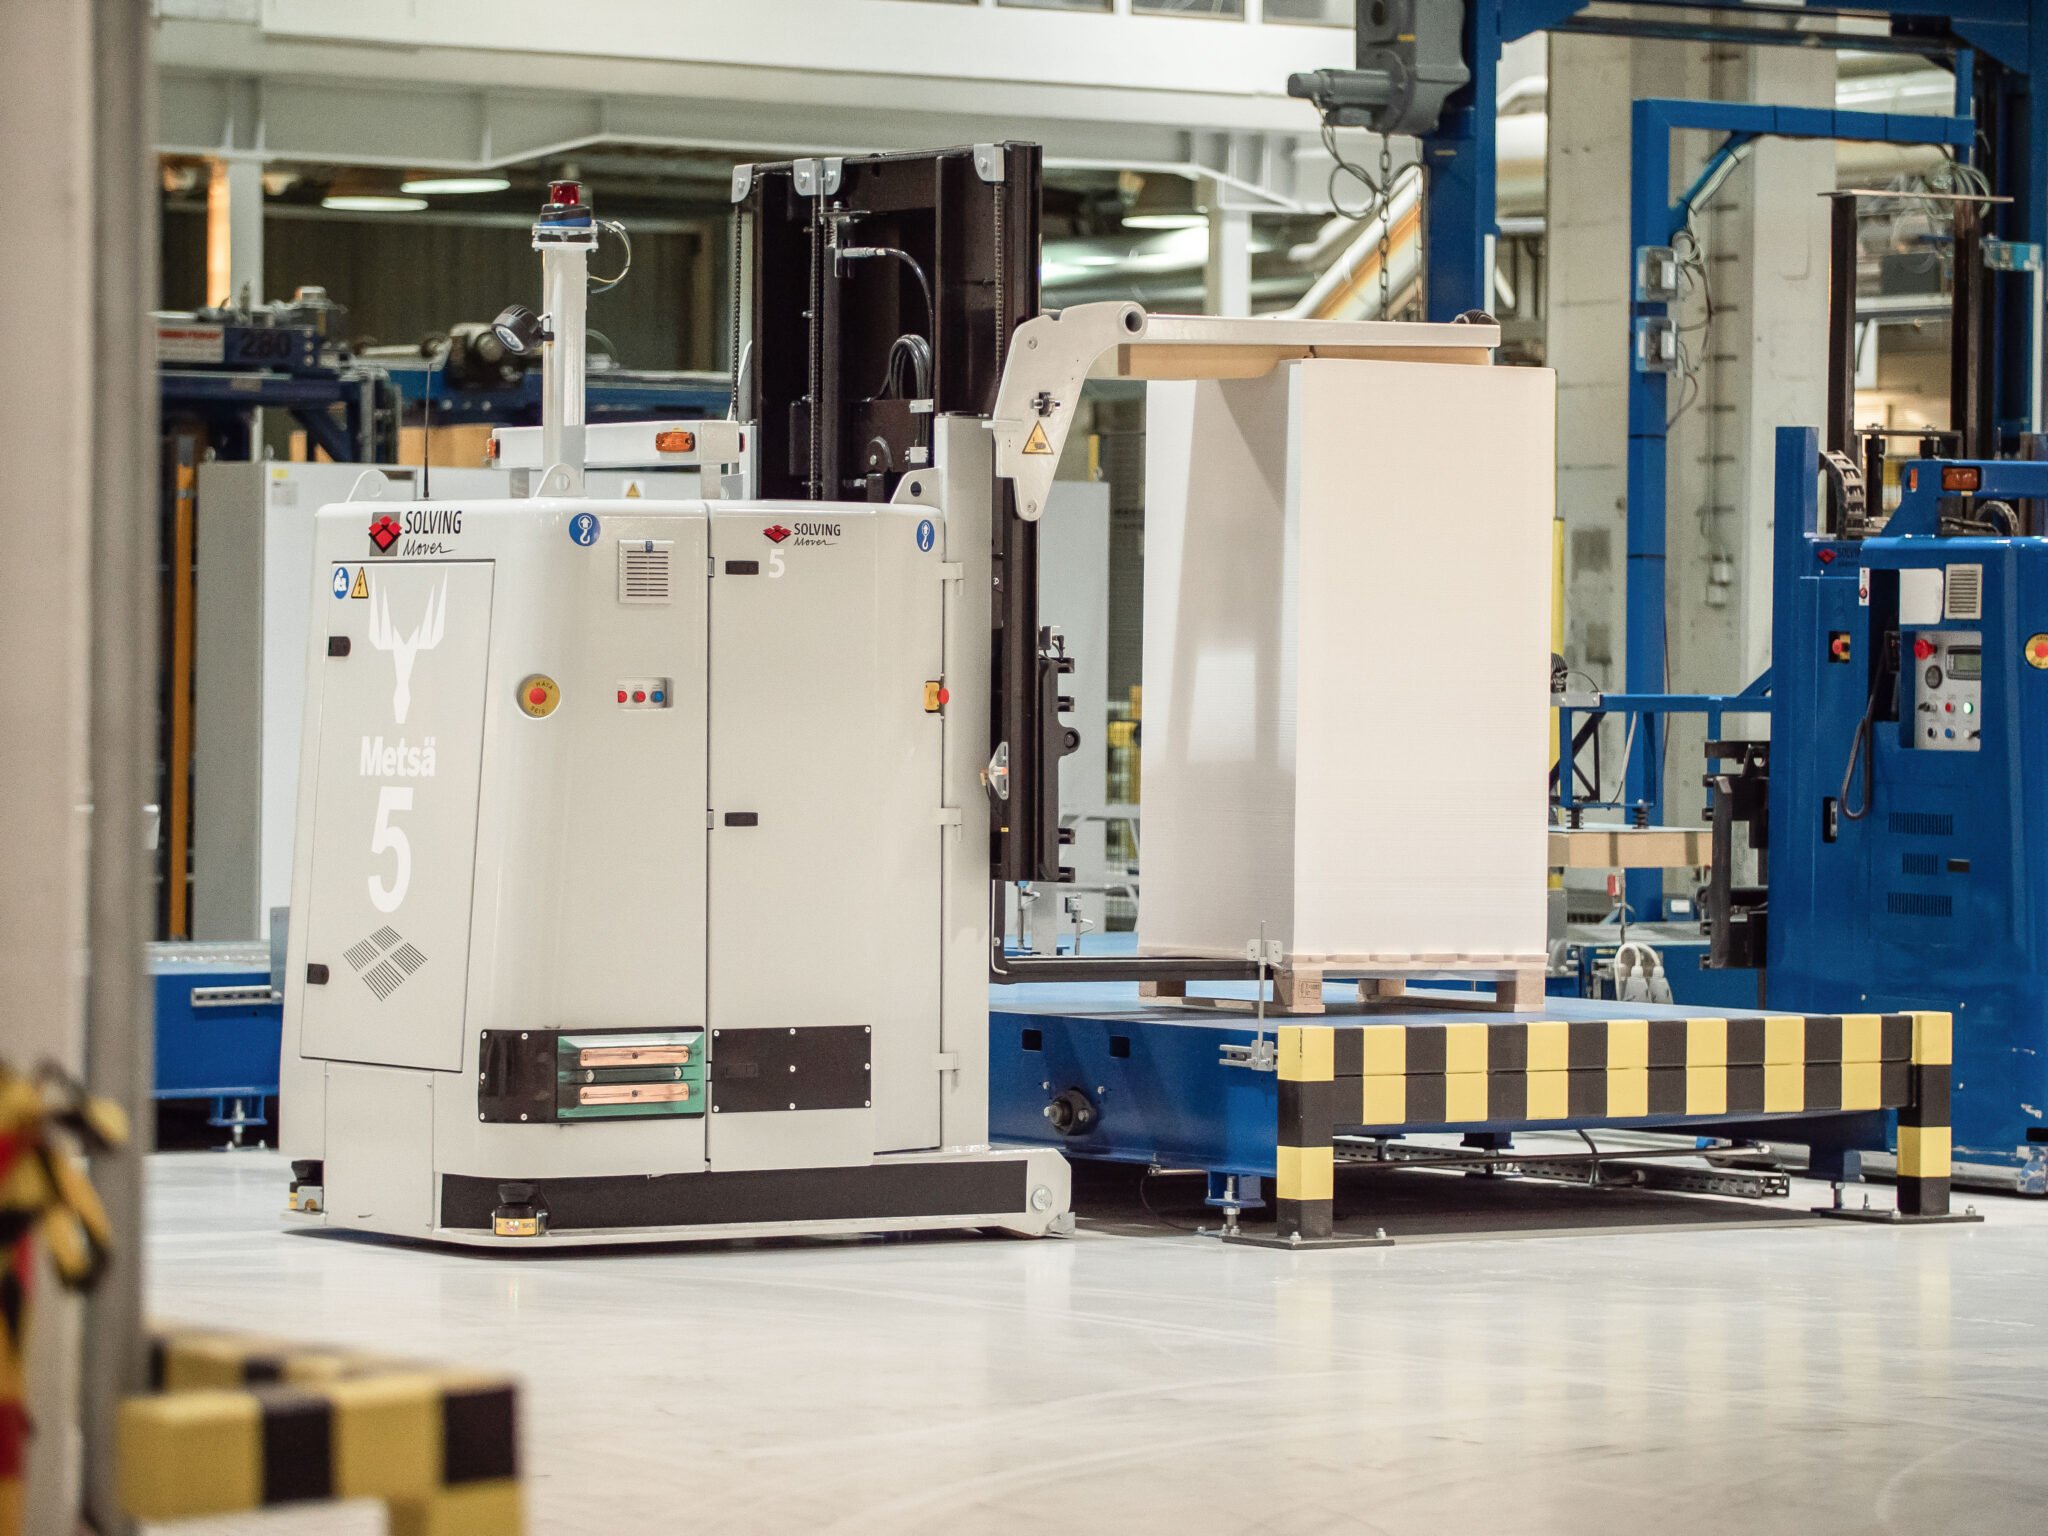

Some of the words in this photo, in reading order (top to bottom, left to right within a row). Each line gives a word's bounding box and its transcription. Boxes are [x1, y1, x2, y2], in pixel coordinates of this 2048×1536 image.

[405, 510, 462, 534] SOLVING
[793, 522, 841, 537] SOLVING
[402, 538, 457, 557] Mover
[793, 537, 839, 547] Mover
[767, 548, 786, 579] 5
[360, 735, 437, 777] Metsä
[367, 785, 414, 913] 5
